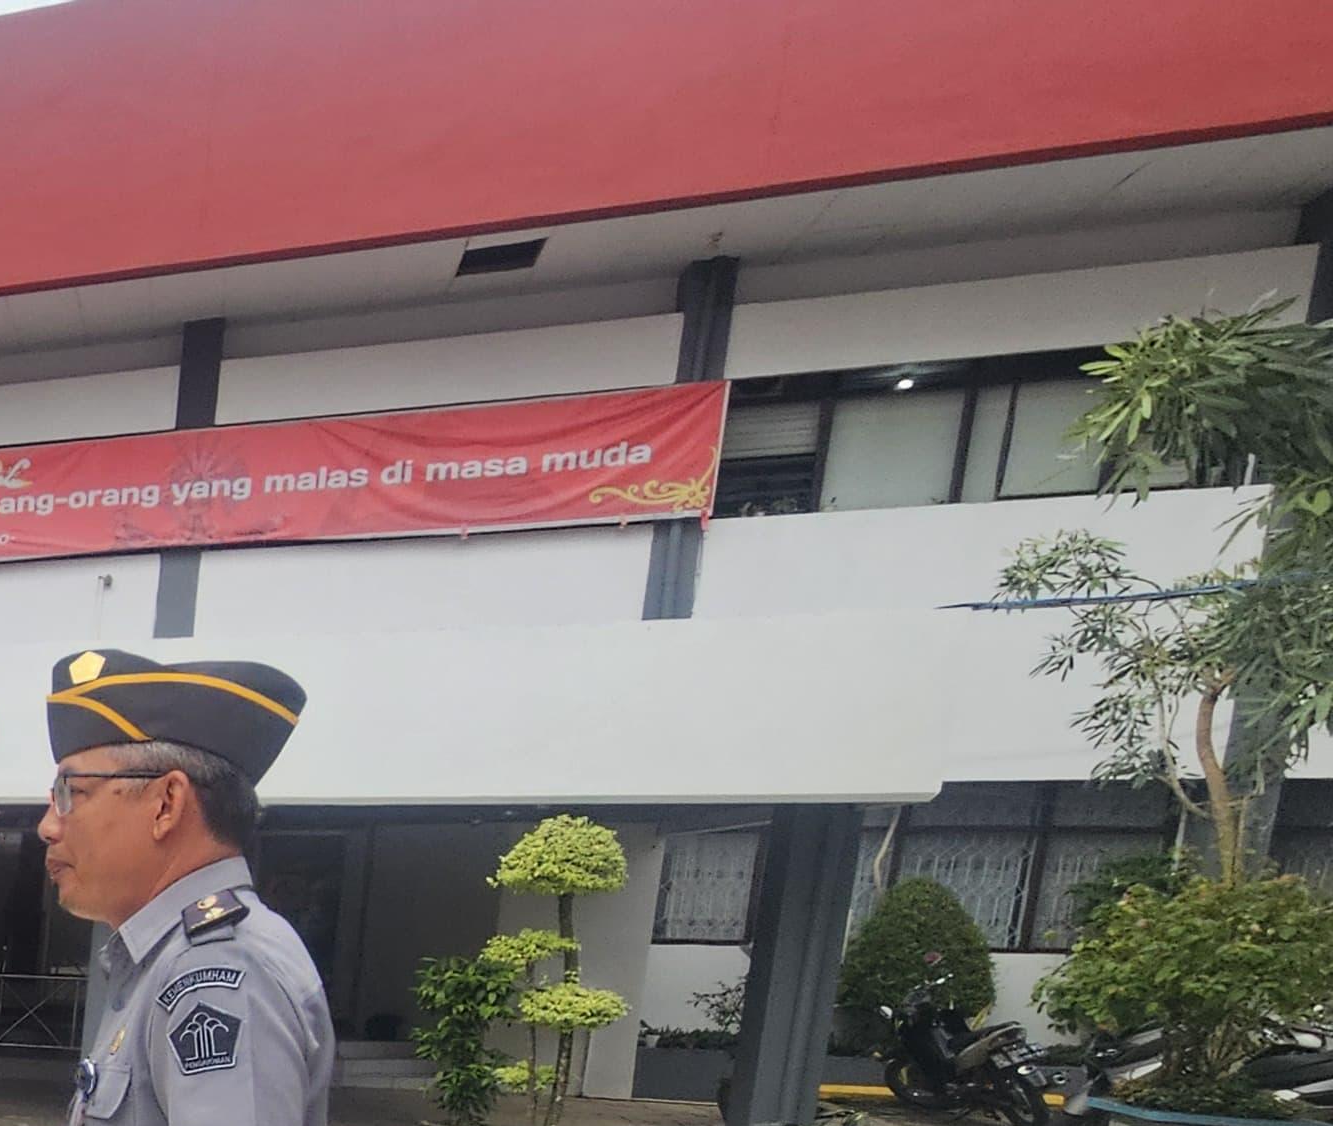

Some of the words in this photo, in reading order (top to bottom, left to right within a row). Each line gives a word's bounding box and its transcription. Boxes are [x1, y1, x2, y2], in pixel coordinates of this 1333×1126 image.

[171, 471, 252, 505] yang
[263, 464, 369, 493] malas
[380, 459, 412, 486] di
[424, 455, 528, 482] masa
[540, 440, 653, 472] muda
